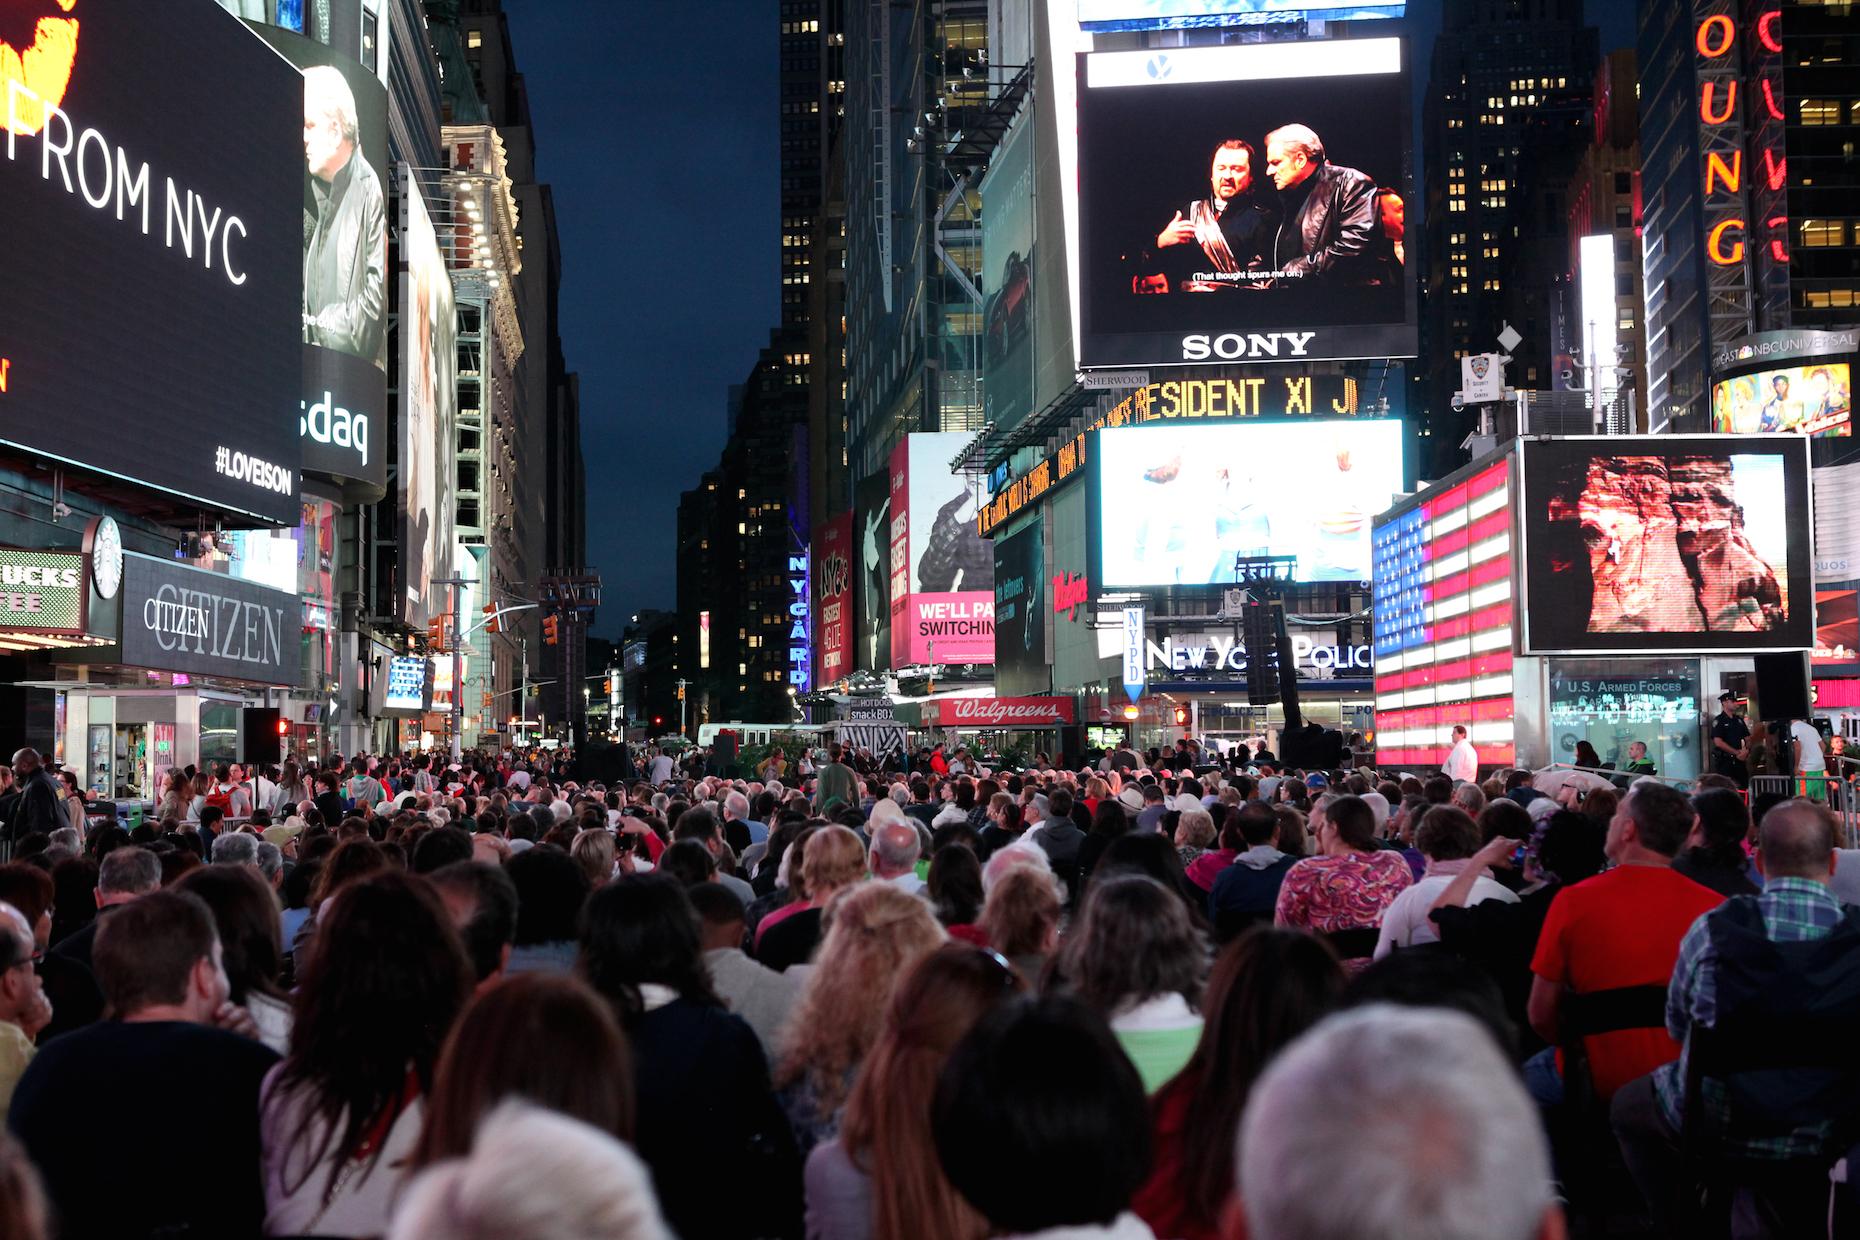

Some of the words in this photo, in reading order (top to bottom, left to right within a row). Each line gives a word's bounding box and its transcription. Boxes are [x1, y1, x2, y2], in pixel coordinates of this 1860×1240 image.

[8, 78, 149, 235] FROM
[166, 176, 247, 285] NYC
[1216, 272, 1246, 281] thought
[1182, 331, 1316, 360] SONY
[1754, 333, 1857, 356] NBCUNIVERSAL
[1086, 375, 1147, 387] SHERWOOD
[1285, 377, 1312, 414] XI
[215, 446, 292, 496] #LOVEISON
[0, 563, 78, 588] UCKS
[144, 598, 209, 639] CITIZEN
[919, 602, 970, 619] WE'LL
[973, 602, 995, 618] PA
[155, 583, 284, 667] CITIZEN
[1128, 611, 1138, 682] NYPD
[1146, 636, 1207, 671] NEW
[1568, 681, 1594, 693] U.S.
[1598, 681, 1636, 693] ARMED
[1639, 681, 1682, 692] FORCES
[1579, 695, 1622, 706] CARR
[953, 700, 1060, 723] Walgreens
